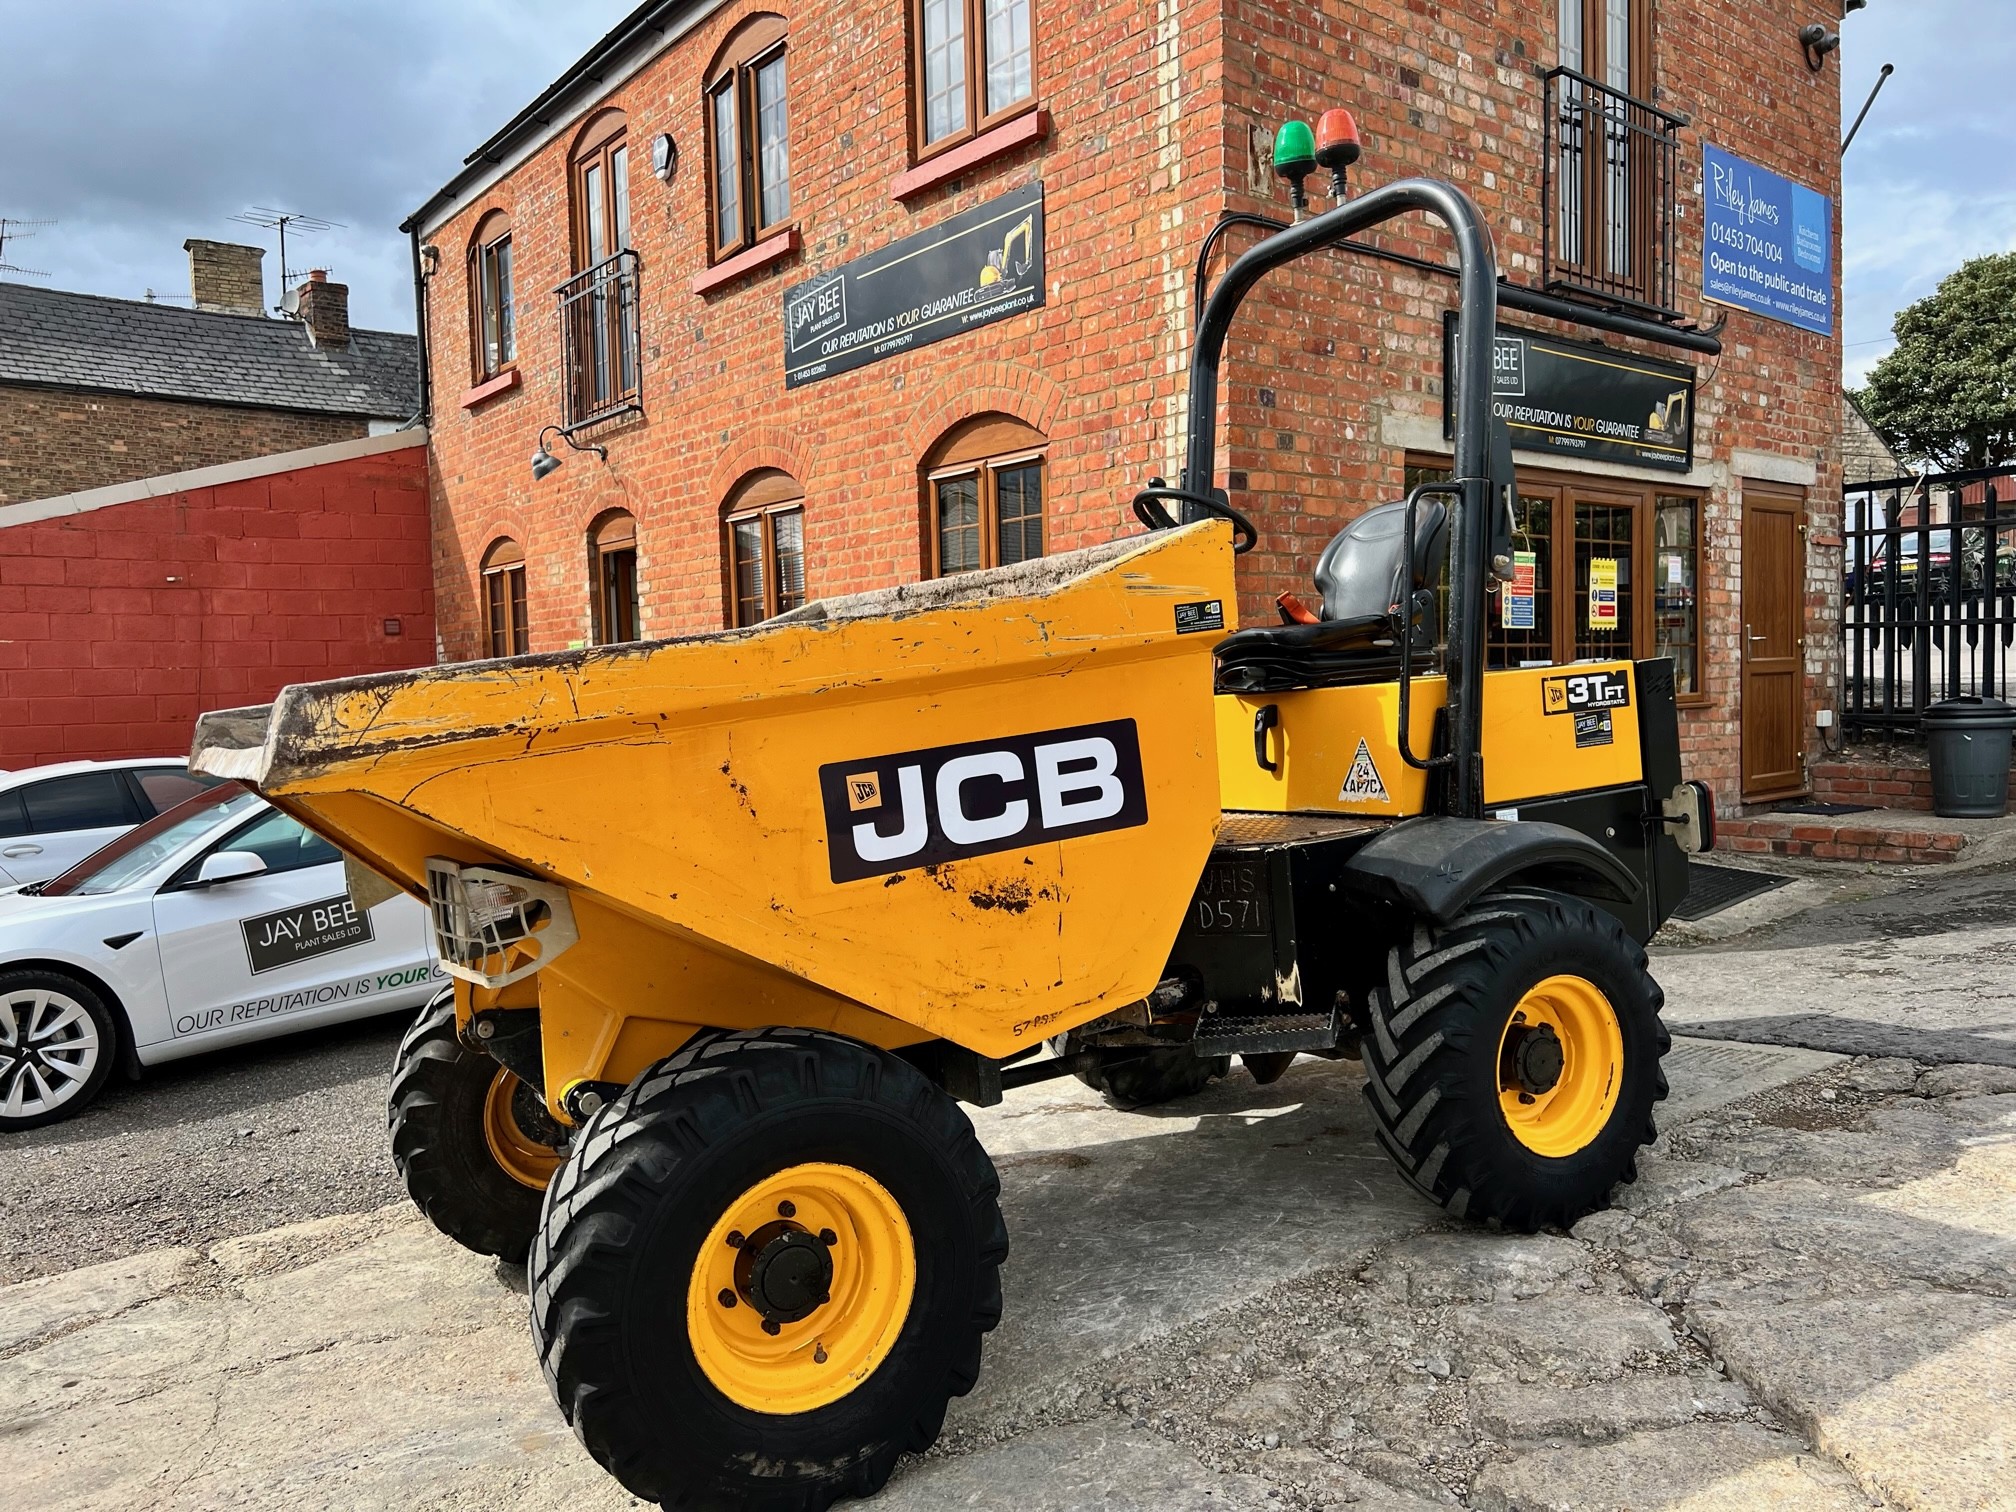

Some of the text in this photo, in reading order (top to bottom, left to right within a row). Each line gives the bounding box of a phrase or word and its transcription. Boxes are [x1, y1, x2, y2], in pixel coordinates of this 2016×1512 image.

[1711, 161, 1780, 226] Riley James
[1711, 222, 1783, 264] 01453 704 004
[1710, 251, 1827, 305] Open to the public and trade
[795, 286, 840, 329] JAY BEE
[1709, 278, 1827, 324] sales@rileyjames.co.uk www.rileyjames.co.uk
[810, 311, 841, 333] PLANT SALES LTD
[821, 288, 974, 355] OUR REPUTATION IS YOUR GUARANTEE
[961, 314, 969, 324] W:
[873, 333, 913, 354] M: 07799793797
[1493, 346, 1518, 370] BEE
[797, 369, 811, 380] 01453
[1496, 376, 1510, 384] SALES
[1493, 402, 1640, 439] OUR REPUTATION IS YOUR GUARANTEE
[1555, 436, 1587, 448] 07799793797
[1550, 688, 1564, 703] JCB
[1587, 698, 1626, 708] HYDROSTATIC
[1577, 719, 1586, 729] JAY
[1586, 717, 1596, 726] BEE
[1356, 762, 1370, 778] 24
[852, 736, 1124, 862] JCB
[856, 781, 876, 803] JCB
[259, 901, 359, 947] JAY BEE
[1200, 900, 1260, 928] D571
[295, 925, 361, 951] PLANT SALES LTD
[176, 1009, 224, 1034] OUR
[230, 983, 351, 1022] REPUTATION
[355, 978, 370, 994] IS
[376, 966, 430, 990] YOUR
